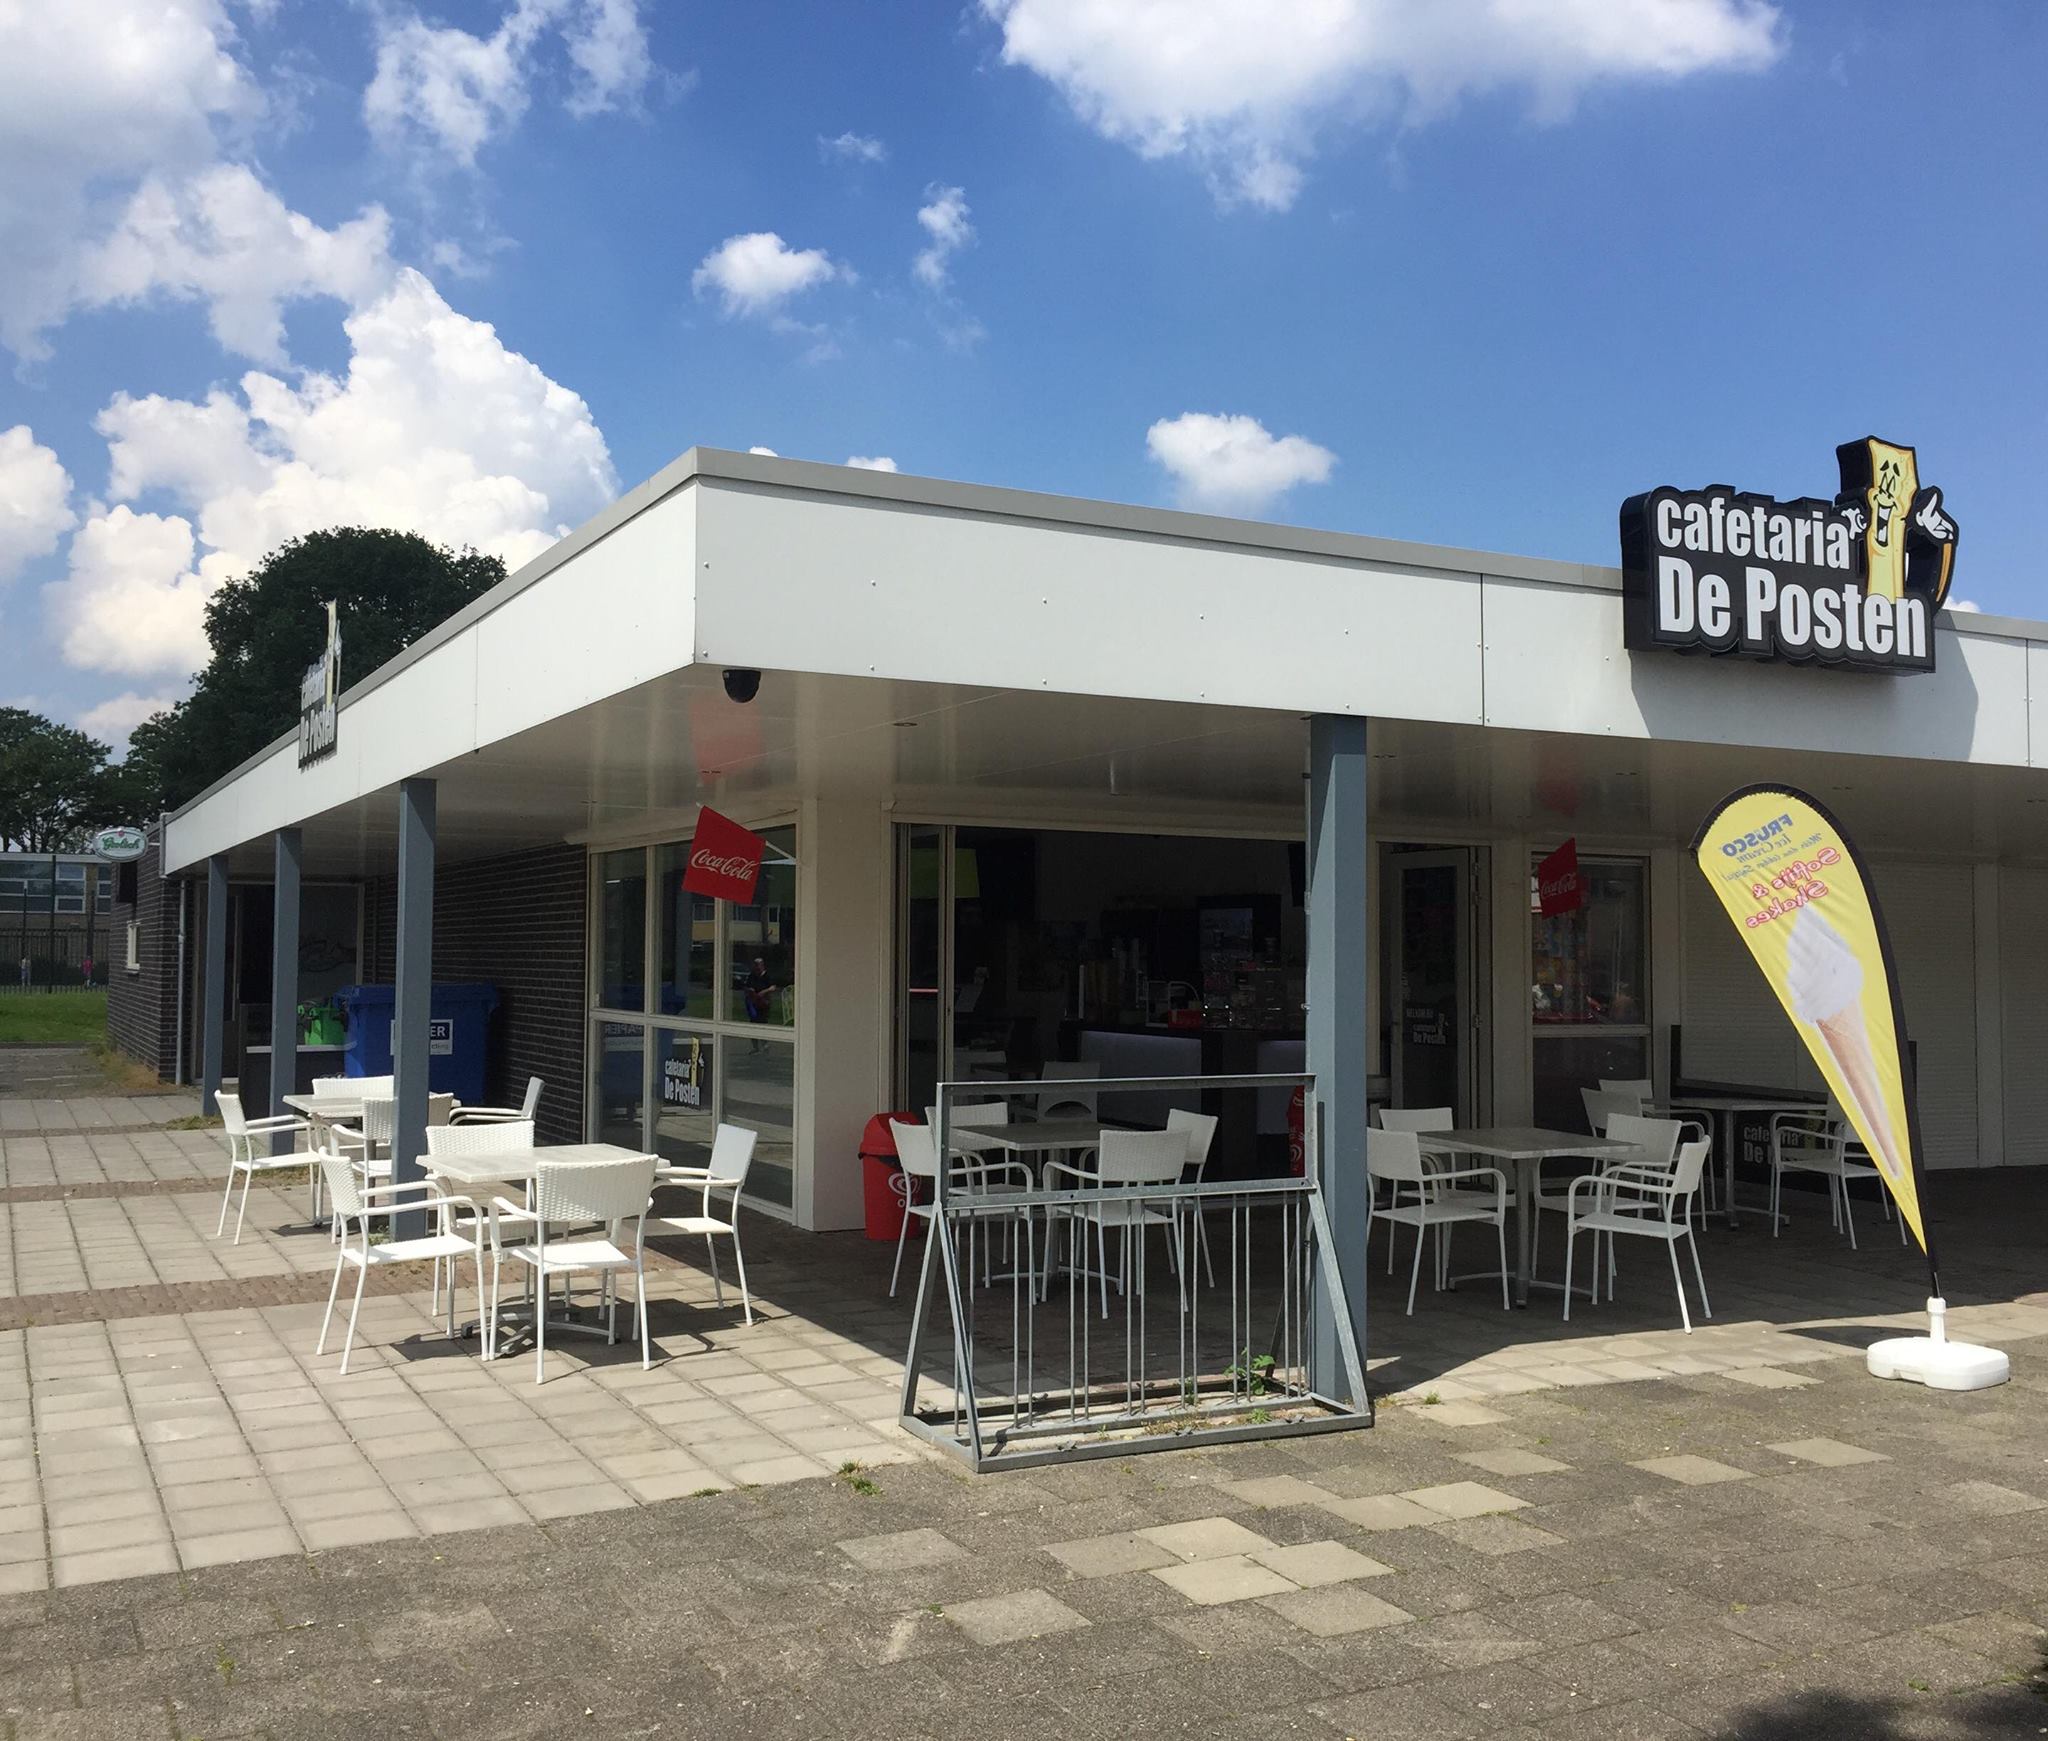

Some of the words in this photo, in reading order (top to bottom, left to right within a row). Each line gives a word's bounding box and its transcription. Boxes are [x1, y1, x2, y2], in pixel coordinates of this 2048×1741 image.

[1657, 498, 1850, 569] cafetaria
[1659, 555, 1731, 638] De
[1745, 566, 1927, 658] Posten
[691, 848, 759, 881] Coca-Cola
[664, 1076, 674, 1100] De
[675, 1078, 700, 1106] Posten
[1743, 1126, 1799, 1146] caferia
